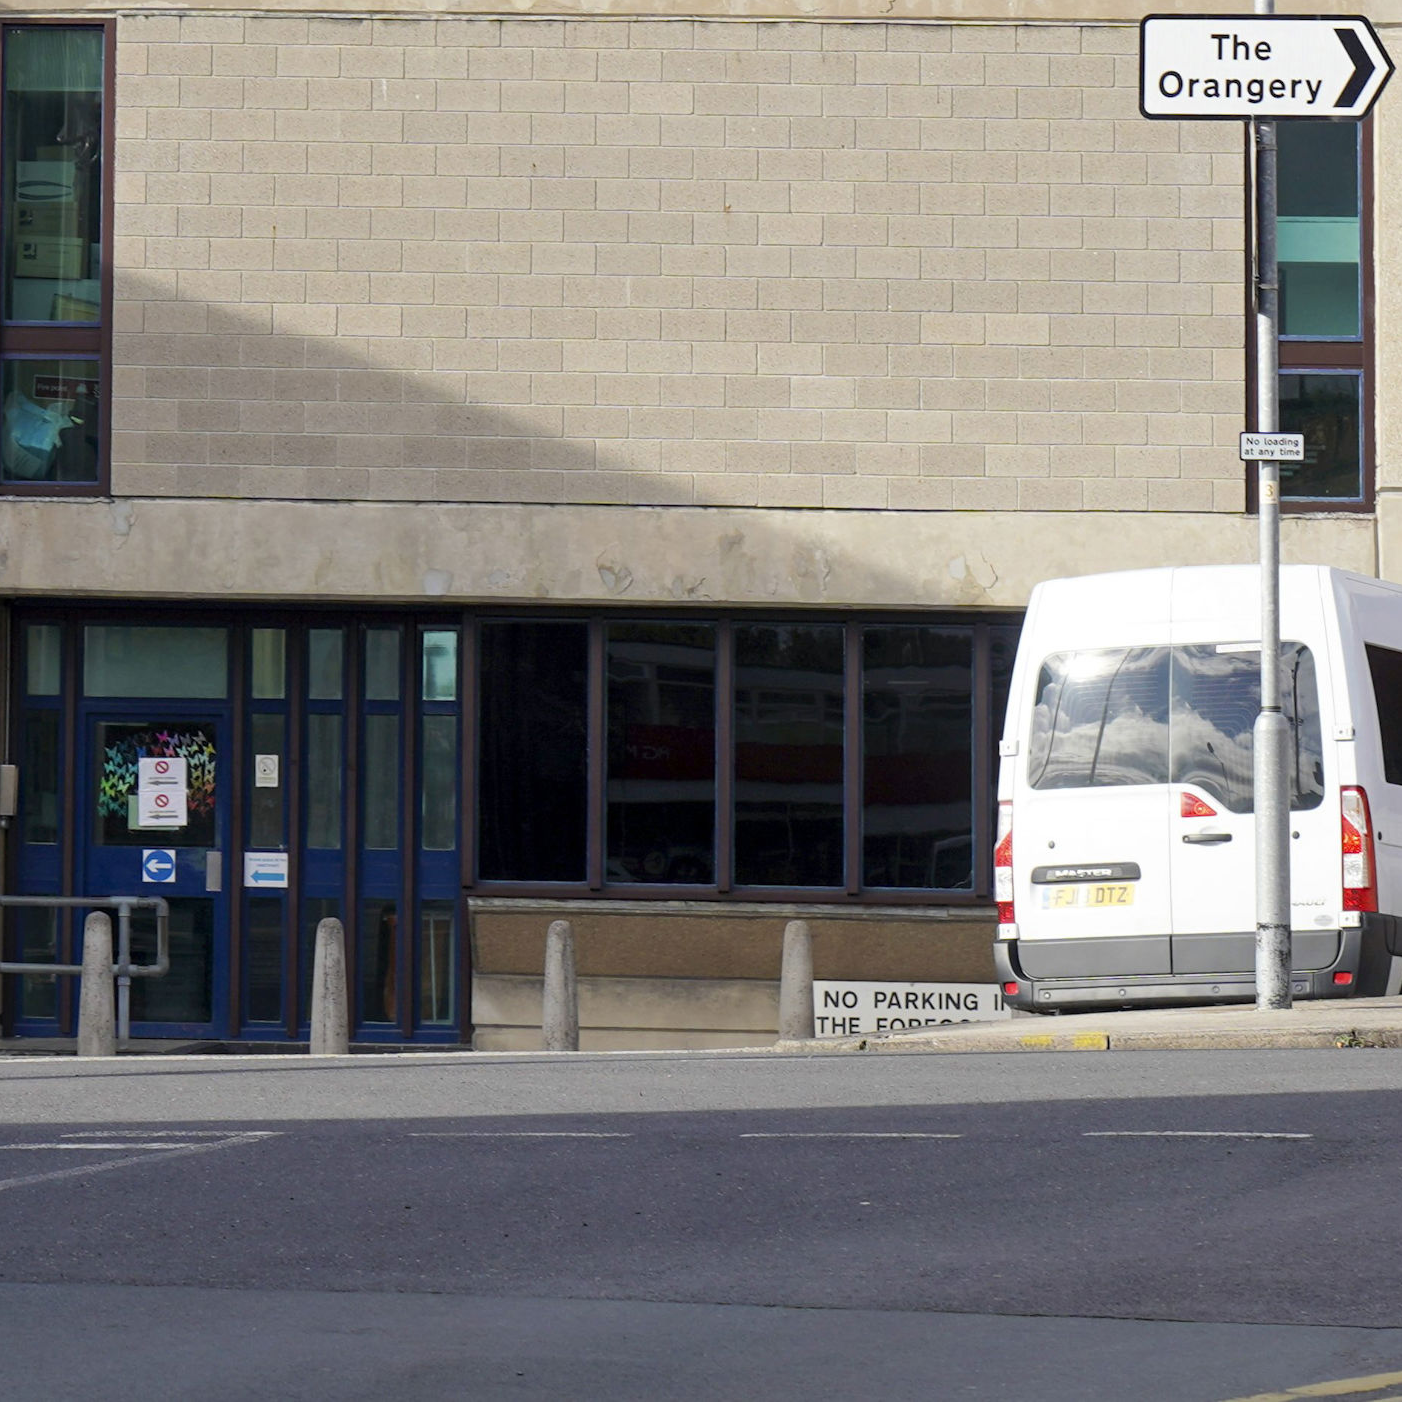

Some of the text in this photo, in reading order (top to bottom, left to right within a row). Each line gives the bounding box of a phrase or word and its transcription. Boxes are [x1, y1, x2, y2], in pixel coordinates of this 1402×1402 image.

[1210, 33, 1272, 61] The
[1158, 70, 1322, 104] Orangery
[1246, 437, 1299, 447] No loading
[1244, 448, 1254, 456] at
[1280, 448, 1301, 456] time
[1055, 868, 1113, 878] MASTER
[1095, 886, 1128, 904] DTZ
[824, 990, 1005, 1011] NO PARKING I
[816, 1016, 861, 1035] THE
